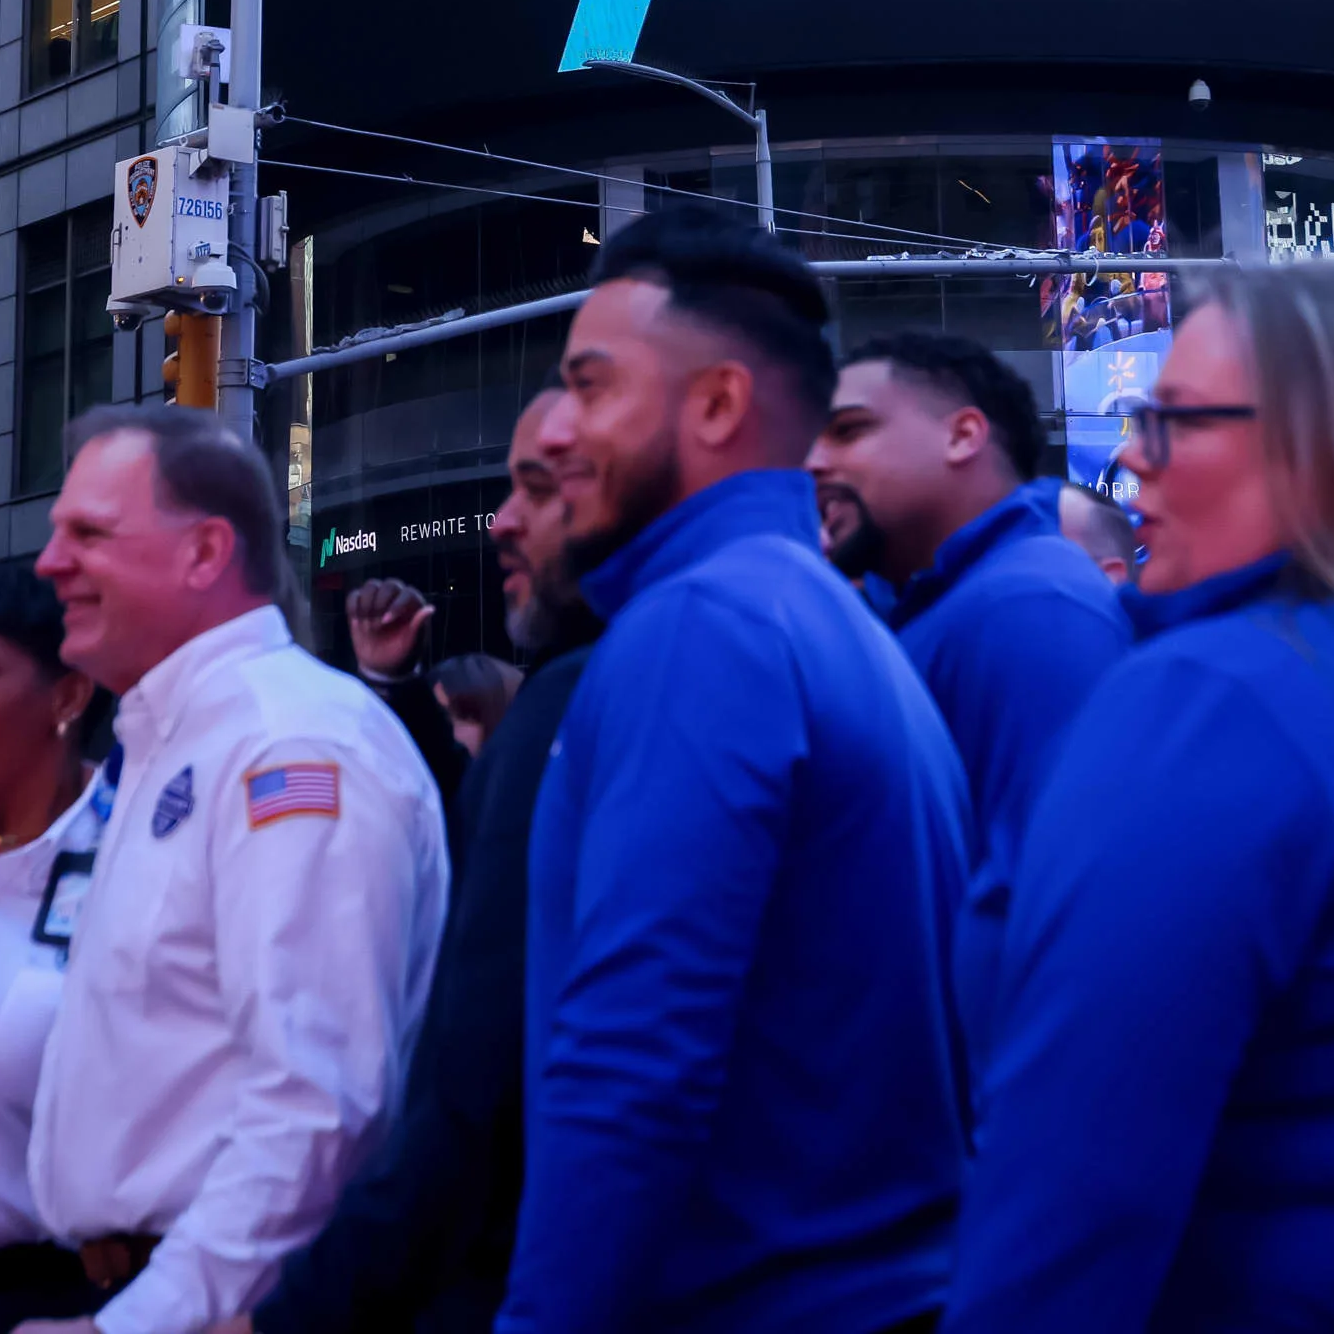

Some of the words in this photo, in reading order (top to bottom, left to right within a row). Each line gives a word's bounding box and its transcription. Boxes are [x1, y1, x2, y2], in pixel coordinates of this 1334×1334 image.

[179, 197, 222, 219] 726156
[400, 517, 466, 543] REWRITE
[474, 513, 499, 530] TO
[335, 529, 377, 555] Nasdaq
